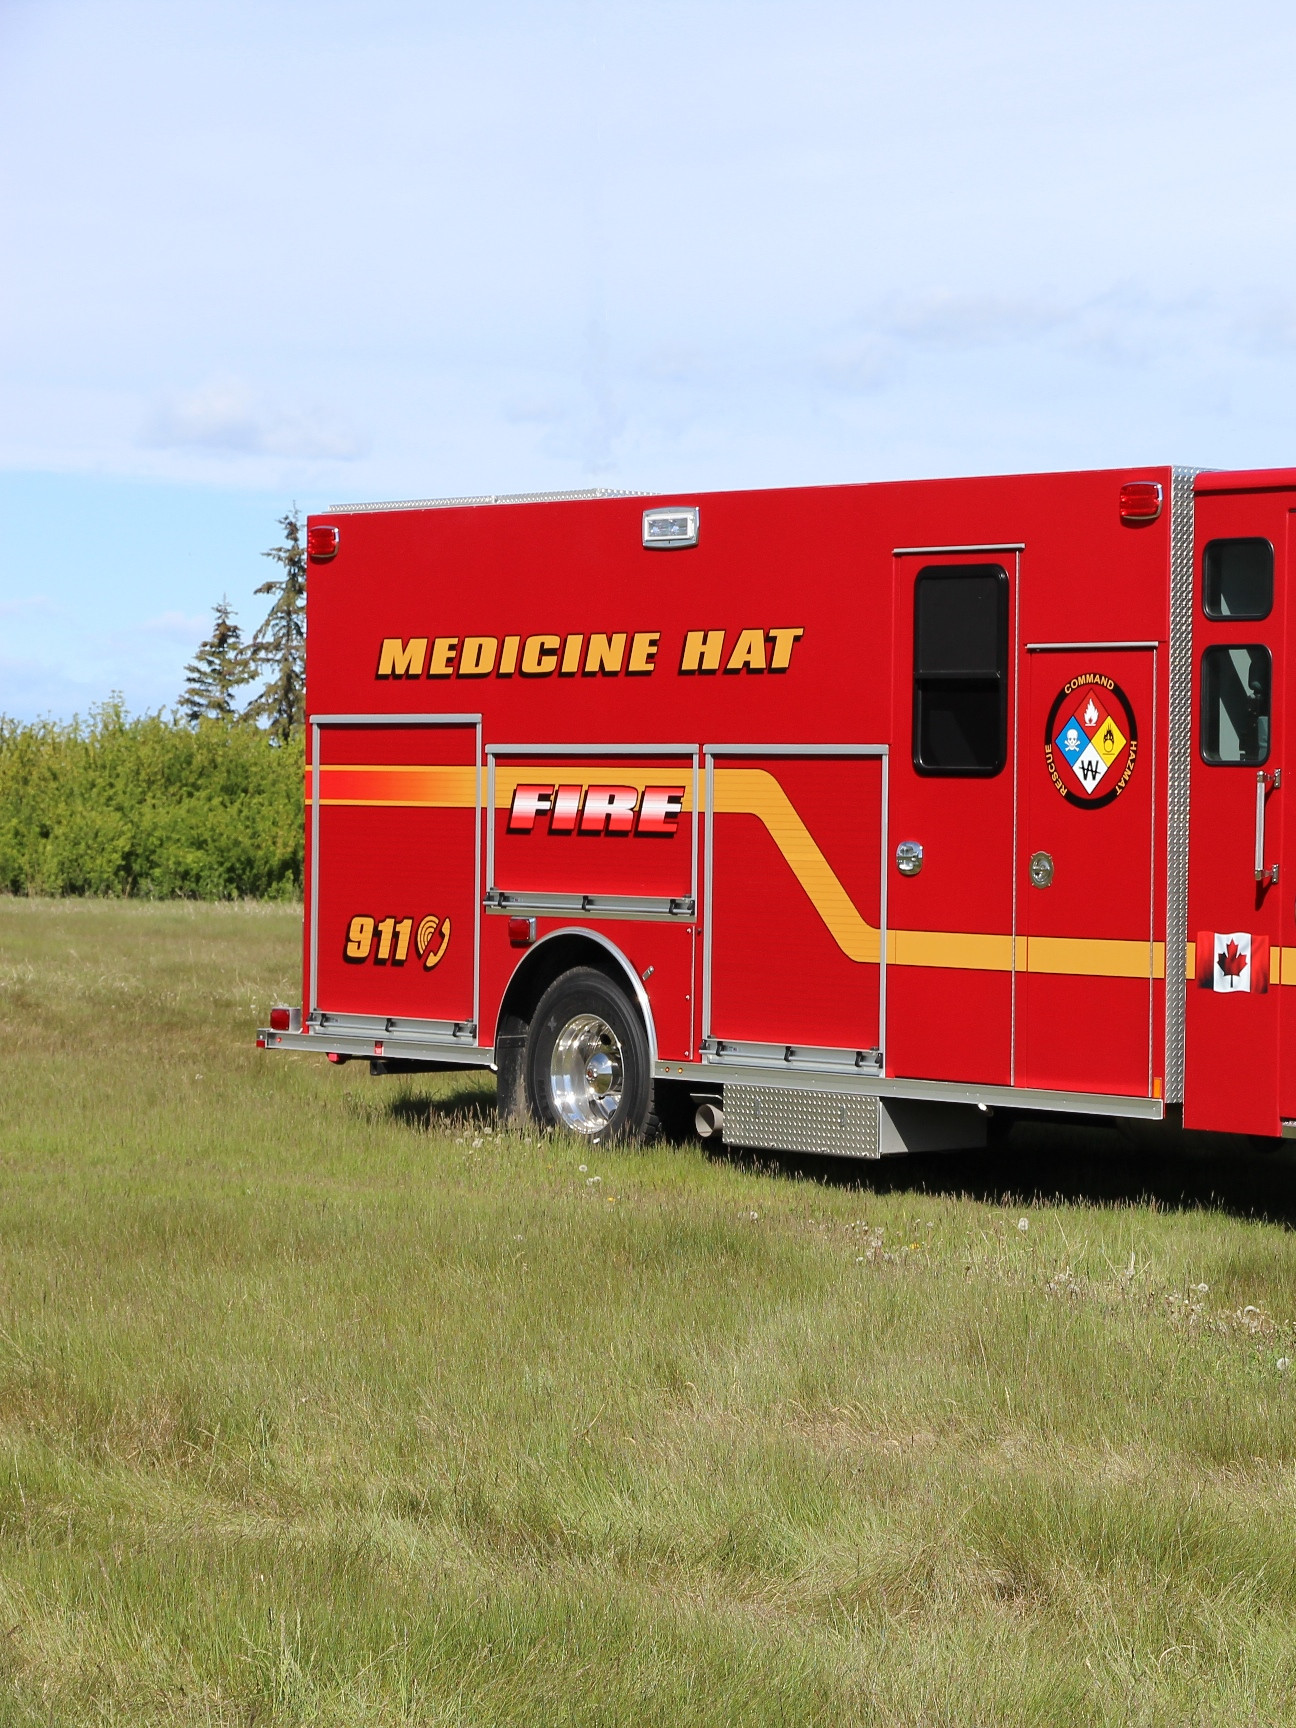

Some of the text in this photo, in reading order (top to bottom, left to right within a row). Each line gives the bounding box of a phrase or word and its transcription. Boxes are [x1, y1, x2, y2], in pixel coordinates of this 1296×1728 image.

[375, 628, 805, 679] MEDICINE HAT
[1064, 673, 1115, 694] COMMAND
[1044, 743, 1068, 797] RESCUE
[1115, 740, 1138, 796] HAZMAT
[507, 784, 686, 837] FIRE
[344, 915, 413, 966] 911
